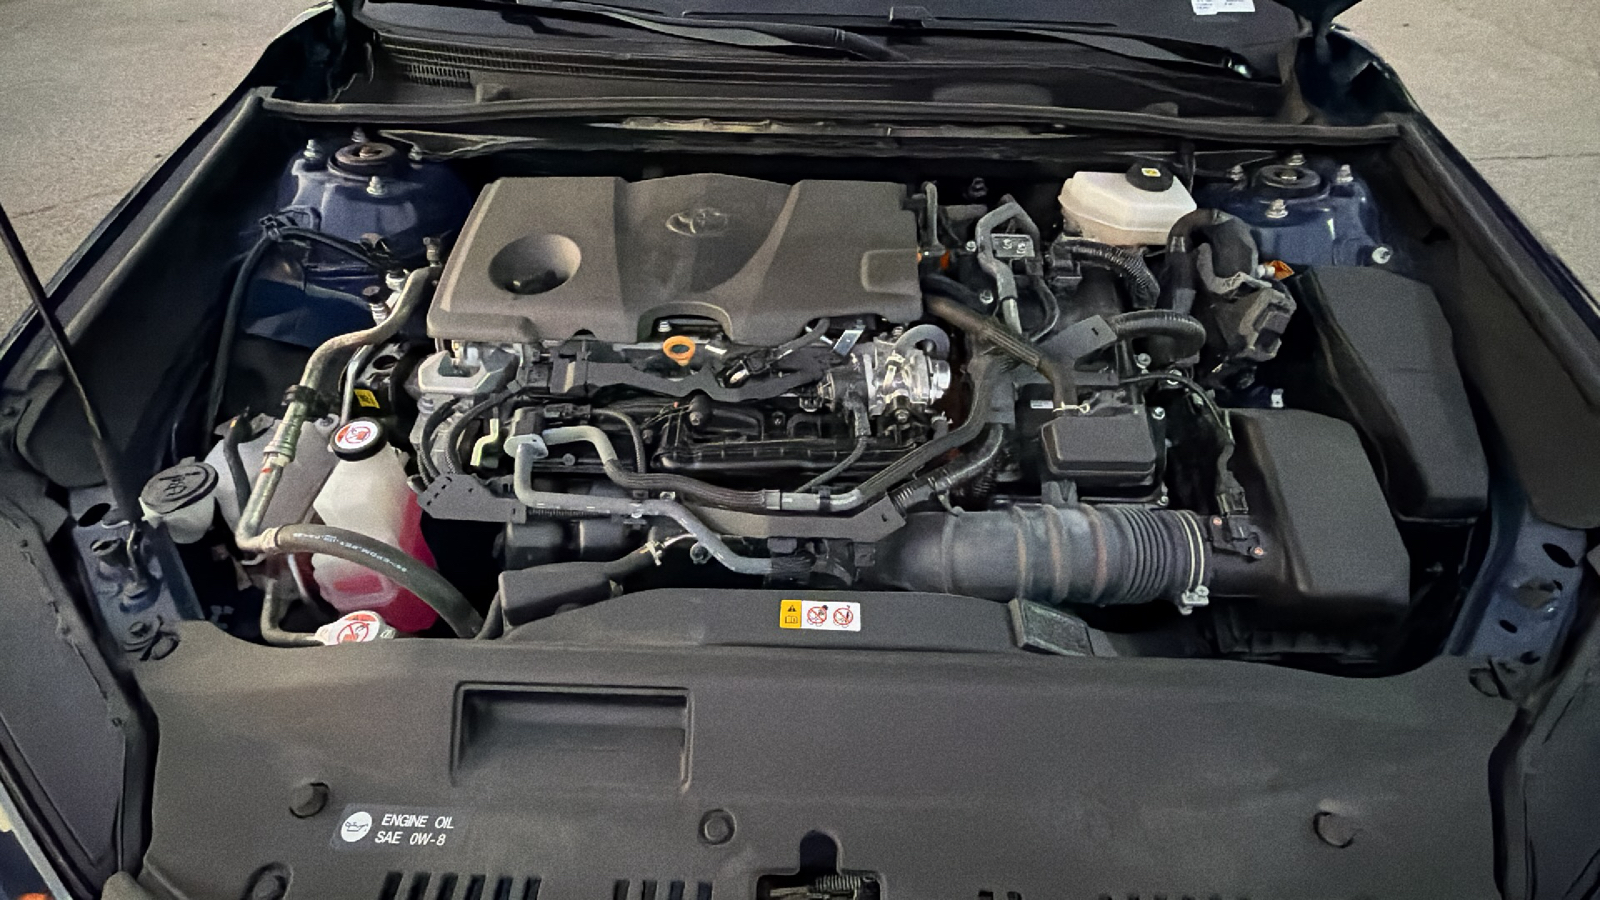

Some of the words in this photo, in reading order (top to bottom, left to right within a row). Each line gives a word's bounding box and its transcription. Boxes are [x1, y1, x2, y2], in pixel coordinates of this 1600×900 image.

[381, 813, 428, 828] ENGINE
[434, 816, 454, 829] OIL
[374, 830, 403, 844] SAE
[409, 832, 446, 846] 0W-8
